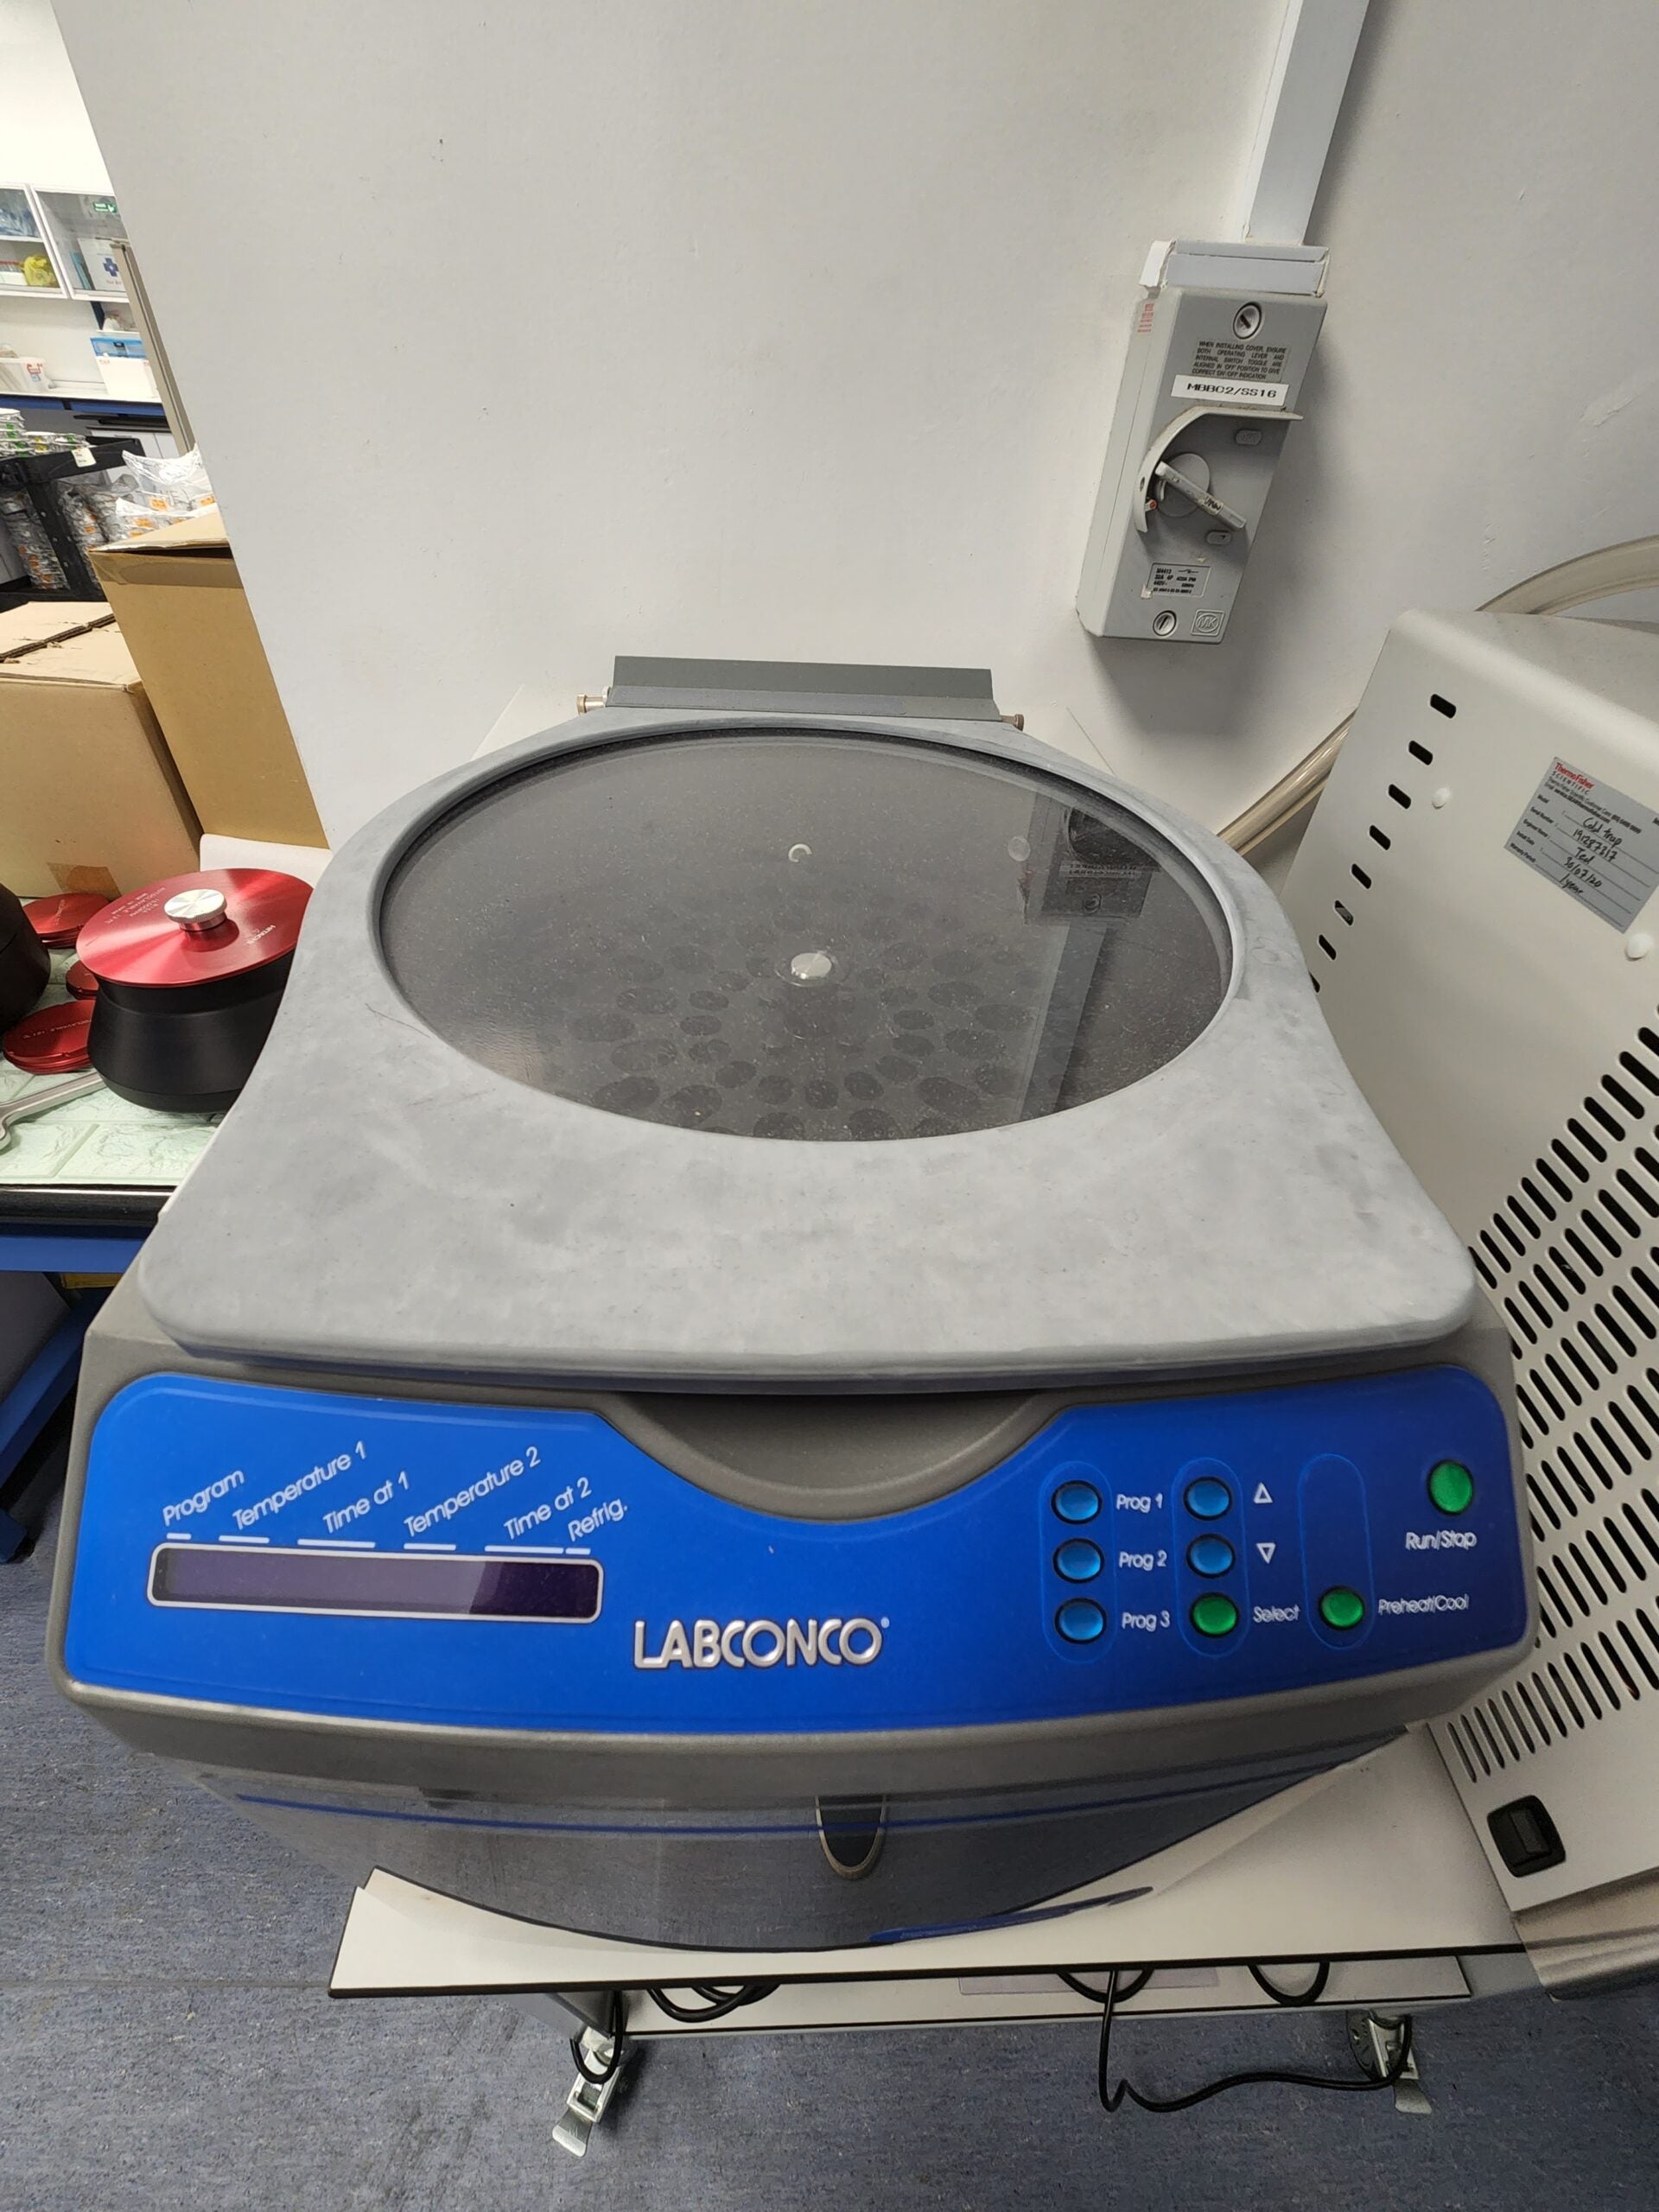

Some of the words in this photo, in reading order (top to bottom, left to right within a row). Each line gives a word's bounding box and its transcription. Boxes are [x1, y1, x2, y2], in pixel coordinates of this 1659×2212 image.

[162, 1470, 245, 1528] Program
[232, 1452, 352, 1531] Temperature
[355, 1440, 367, 1460] 1
[323, 1498, 371, 1535] Time
[372, 1484, 395, 1508] at
[397, 1471, 410, 1491] 1
[404, 1459, 524, 1538] Temperature
[524, 1446, 543, 1467] 2
[504, 1506, 553, 1541] Time
[554, 1492, 576, 1514] at
[575, 1477, 593, 1498] 2
[1116, 1494, 1152, 1513] Prog
[1154, 1493, 1163, 1509] 1
[568, 1496, 629, 1543] Refrig.
[1405, 1530, 1478, 1551] Run/Stop
[1119, 1552, 1154, 1571] Prog
[1155, 1550, 1167, 1567] 2
[1122, 1611, 1159, 1631] Prog
[1160, 1611, 1171, 1628] 3
[1253, 1605, 1300, 1624] Select
[1378, 1593, 1469, 1614] Preheat/Cool
[633, 1618, 883, 1669] LABCONCO
